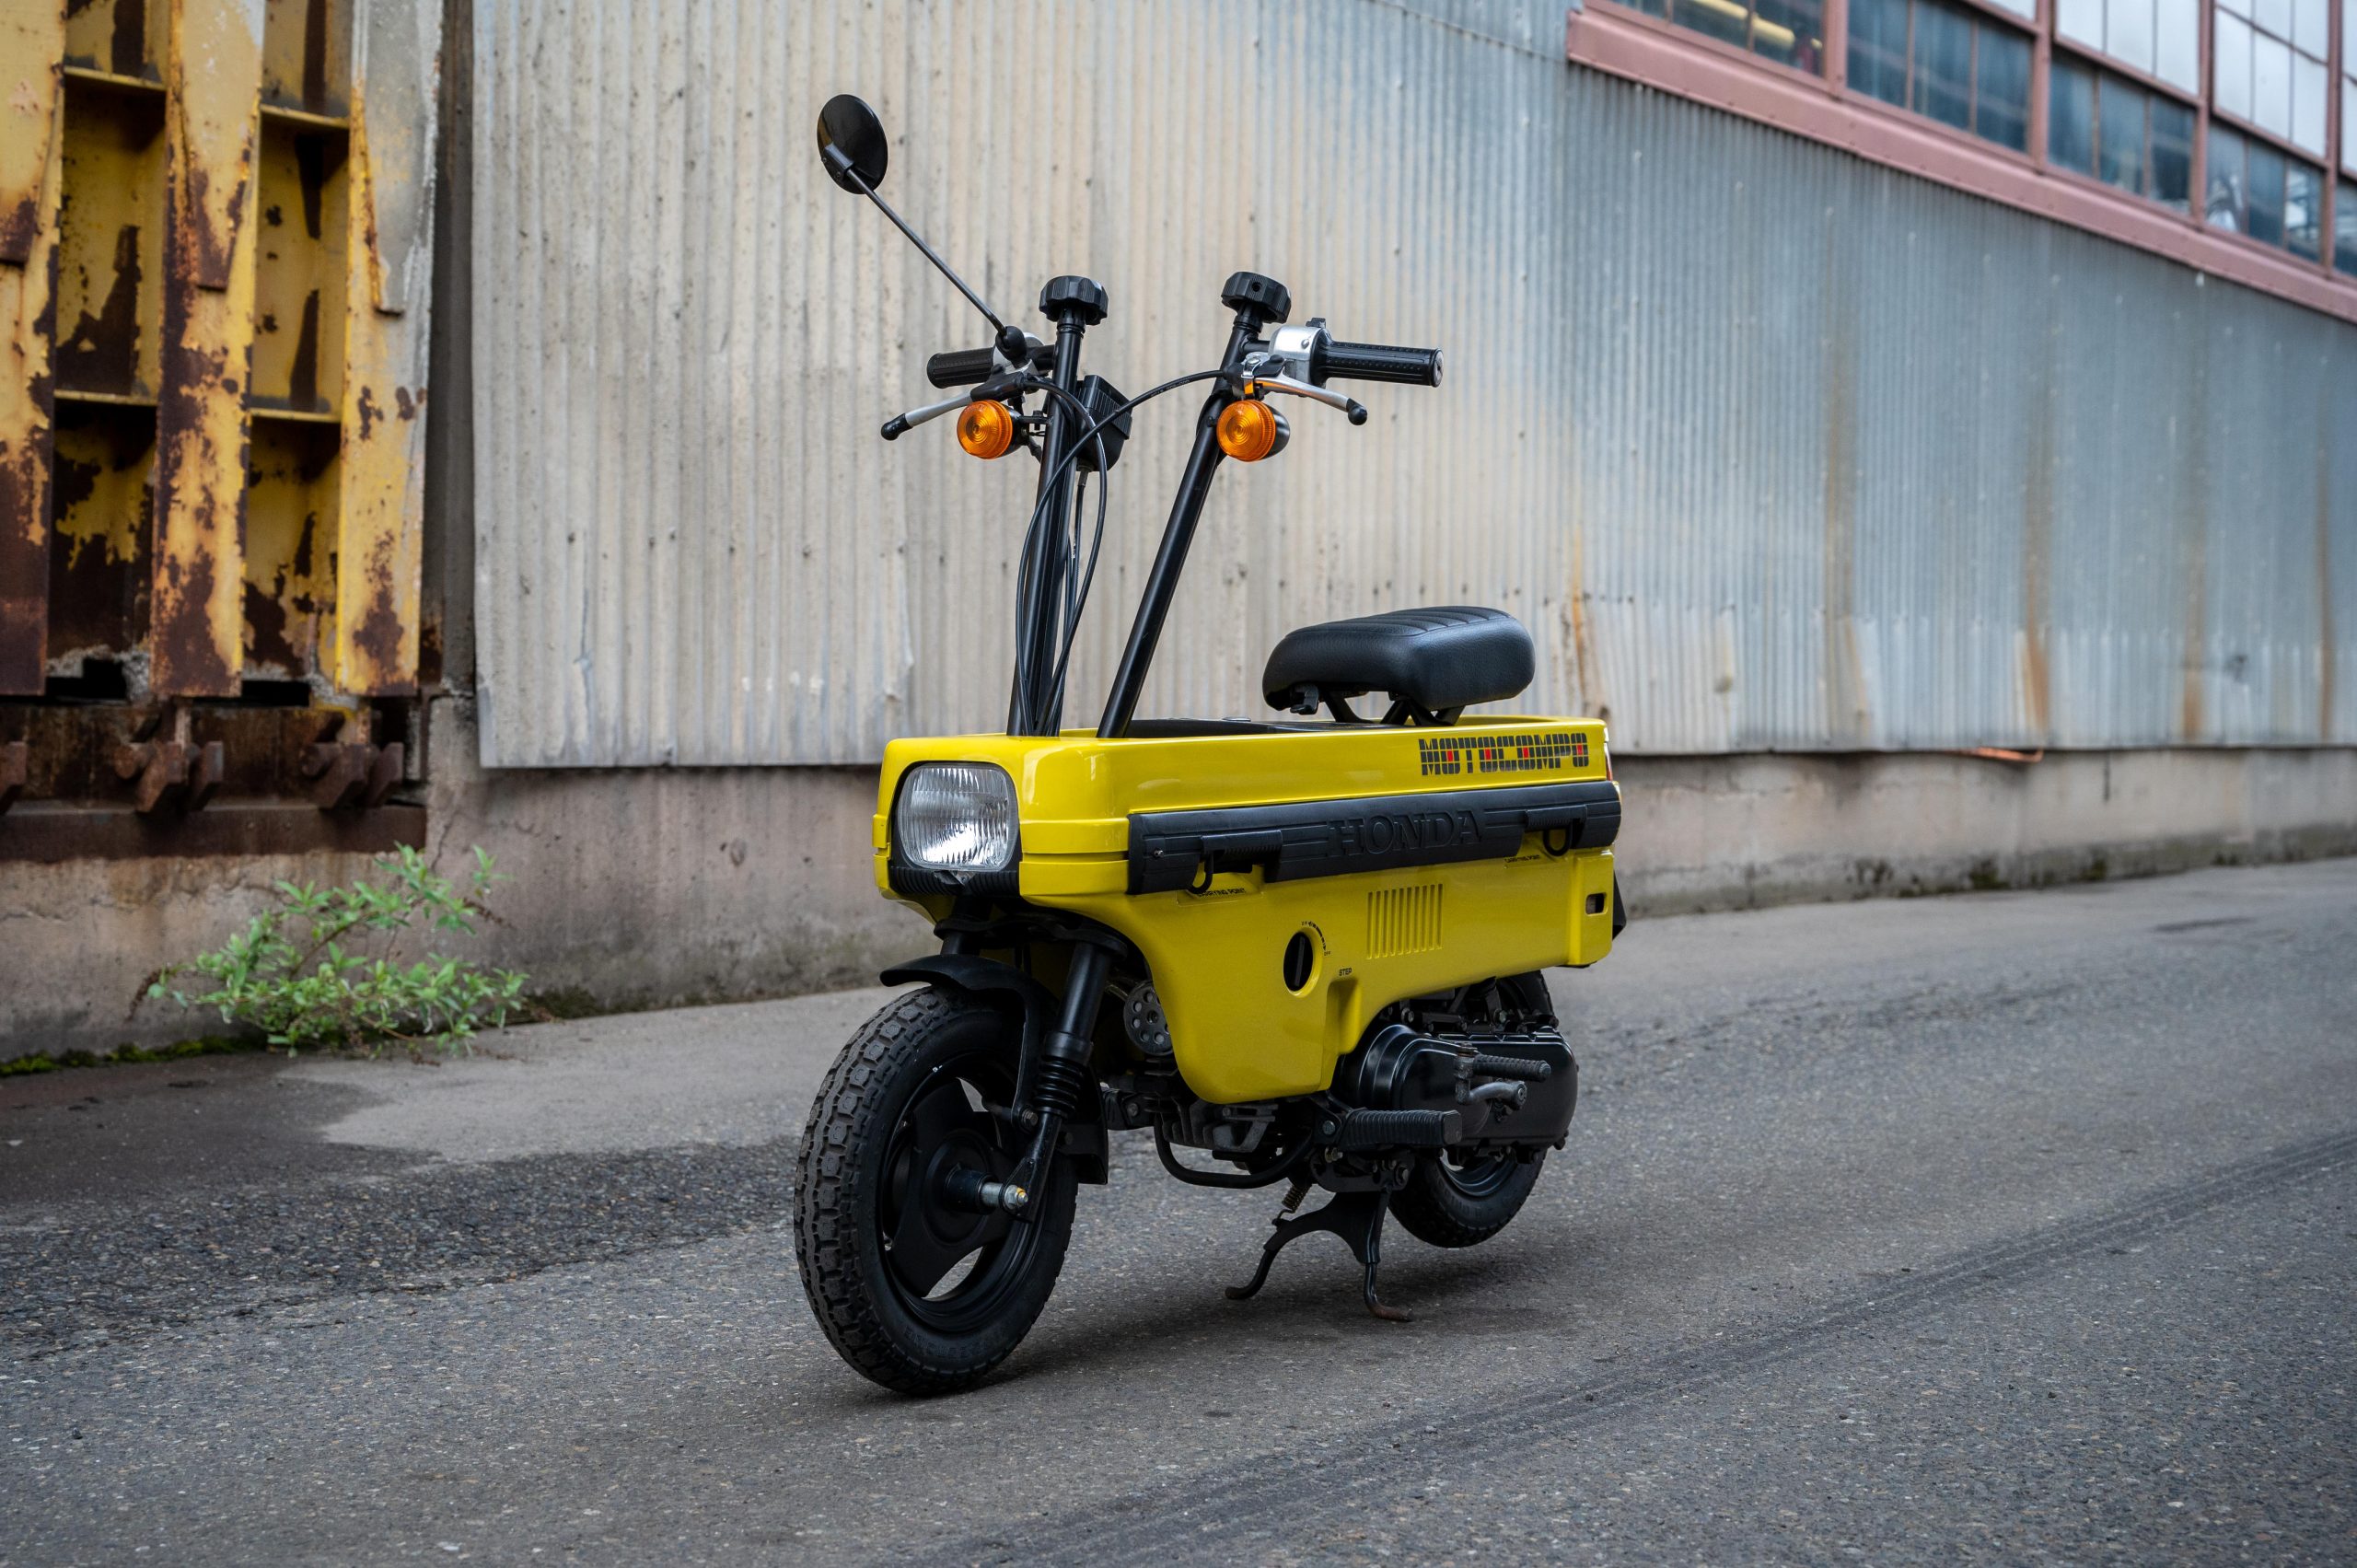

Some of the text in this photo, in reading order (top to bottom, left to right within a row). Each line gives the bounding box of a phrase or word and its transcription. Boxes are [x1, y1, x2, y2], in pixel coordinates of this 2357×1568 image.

[1419, 733, 1589, 776] MOTOCOMPO
[1327, 809, 1482, 857] HONDA
[1339, 968, 1353, 976] STEP
